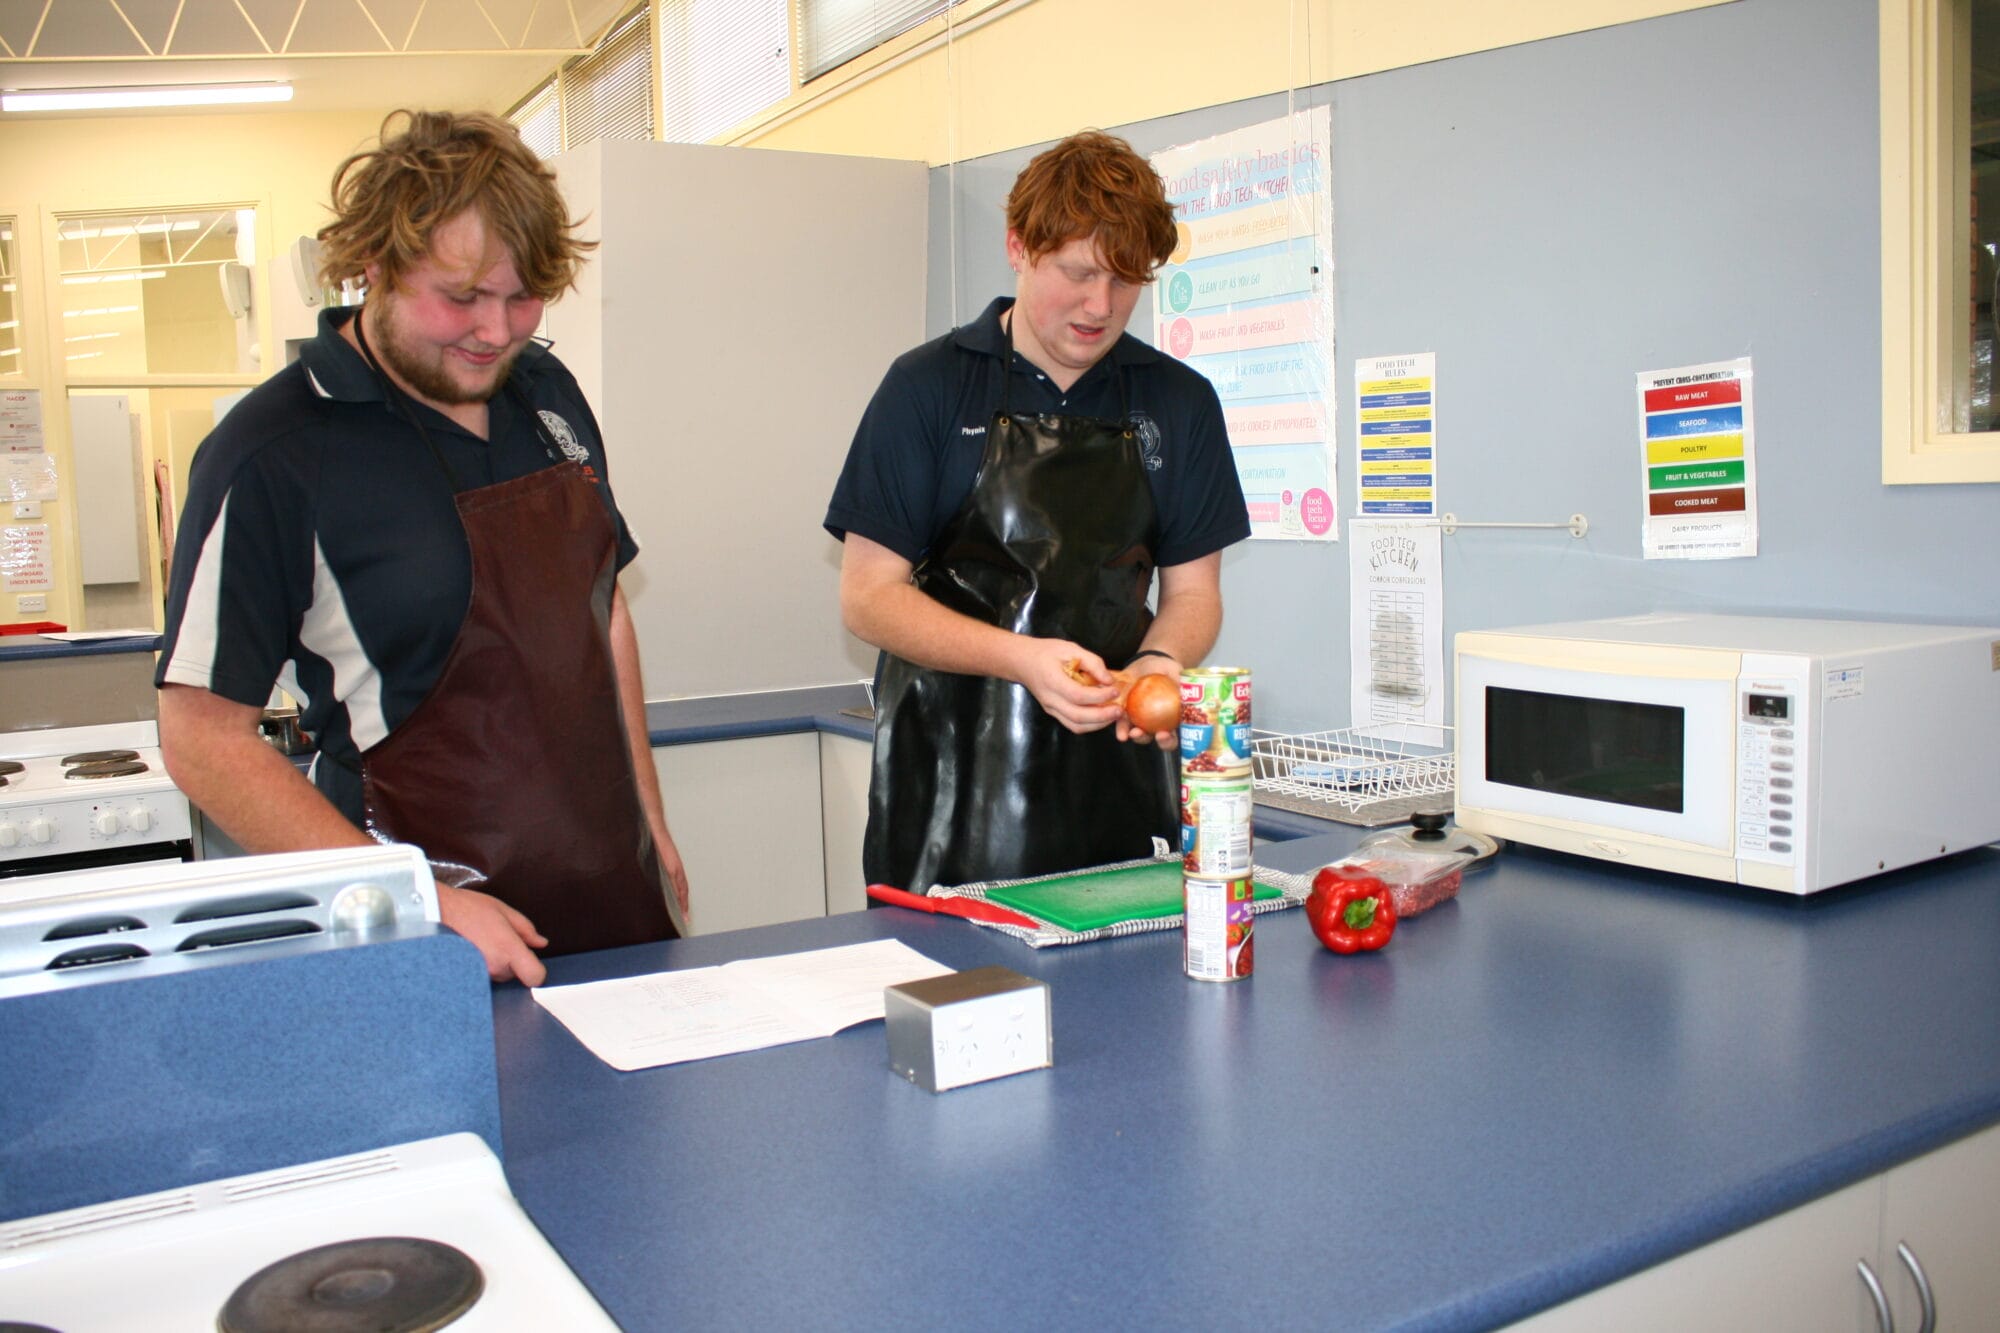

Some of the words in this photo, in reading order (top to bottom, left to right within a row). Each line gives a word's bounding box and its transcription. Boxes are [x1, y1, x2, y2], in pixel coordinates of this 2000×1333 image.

[1257, 142, 1321, 173] basics
[1178, 202, 1187, 217] IN
[1191, 197, 1206, 214] THE
[1234, 186, 1254, 204] TECH
[1199, 279, 1217, 294] CLEAN
[1219, 278, 1228, 289] UP
[1229, 277, 1237, 289] AS
[1238, 275, 1249, 287] YOU
[1250, 273, 1261, 285] GO
[1199, 327, 1216, 341] WASH
[1217, 325, 1235, 339] FRUIT
[1249, 318, 1285, 335] VEGETABLES
[1376, 360, 1395, 370] FOOD
[1396, 359, 1415, 368] TECH
[1384, 368, 1406, 378] RULES
[1653, 377, 1675, 387] PREVENT
[1676, 369, 1734, 385] CROSS-CONTAMINATION
[1675, 392, 1690, 402] RAW
[1691, 391, 1708, 400] MEAT
[1240, 421, 1246, 432] IS
[1679, 418, 1707, 428] SEAFOOD
[1681, 445, 1707, 454] POULTRY
[1666, 473, 1683, 482] FRUIT
[1684, 472, 1689, 480] &
[1690, 469, 1727, 480] VEGETABLES
[1307, 495, 1322, 505] food
[1675, 498, 1700, 508] COOKED
[1700, 497, 1718, 506] MEAT
[1308, 504, 1323, 514] tech
[1308, 513, 1326, 523] focus
[1672, 525, 1690, 534] DAIRY
[1691, 523, 1722, 533] PRODUCTS
[1370, 536, 1395, 552] FOOD
[1397, 537, 1416, 553] TECH
[1369, 548, 1419, 573] KITCHEN
